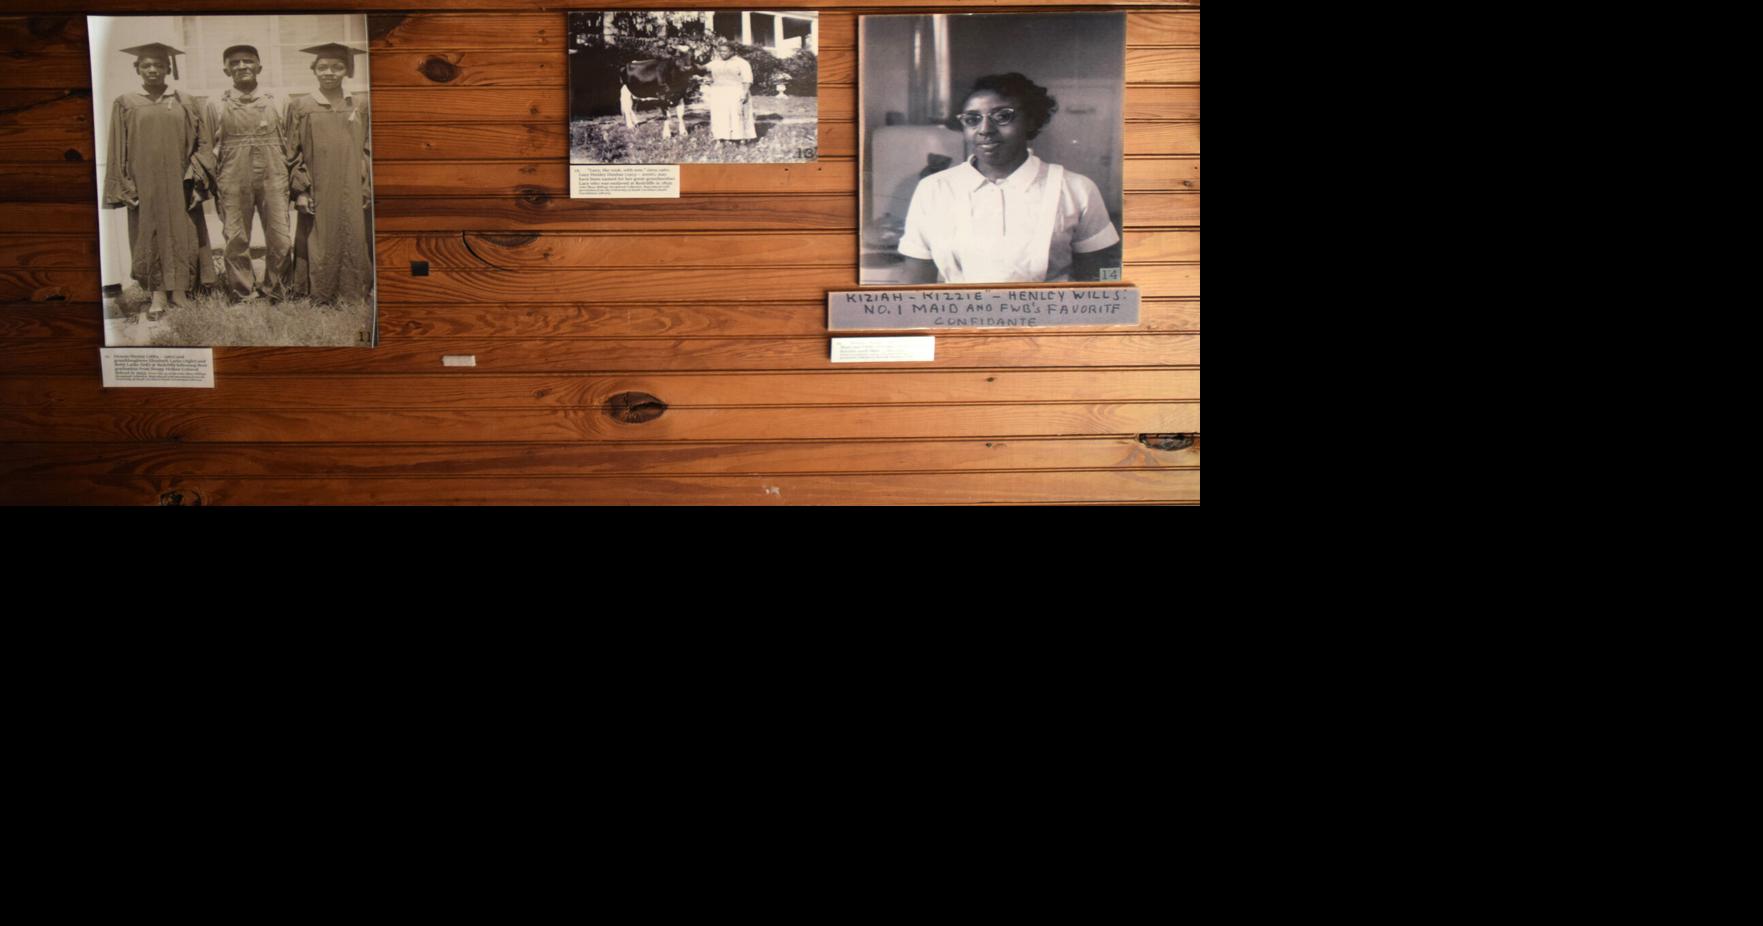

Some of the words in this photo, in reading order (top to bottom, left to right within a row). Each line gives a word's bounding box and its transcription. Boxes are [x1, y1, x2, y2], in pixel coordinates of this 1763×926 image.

[1102, 269, 1119, 280] 14
[846, 293, 903, 303] KIZIAH
[864, 304, 892, 315] NO.
[911, 303, 959, 314] MAID
[966, 303, 993, 313] AND
[934, 317, 1037, 328] CONFIDANTE
